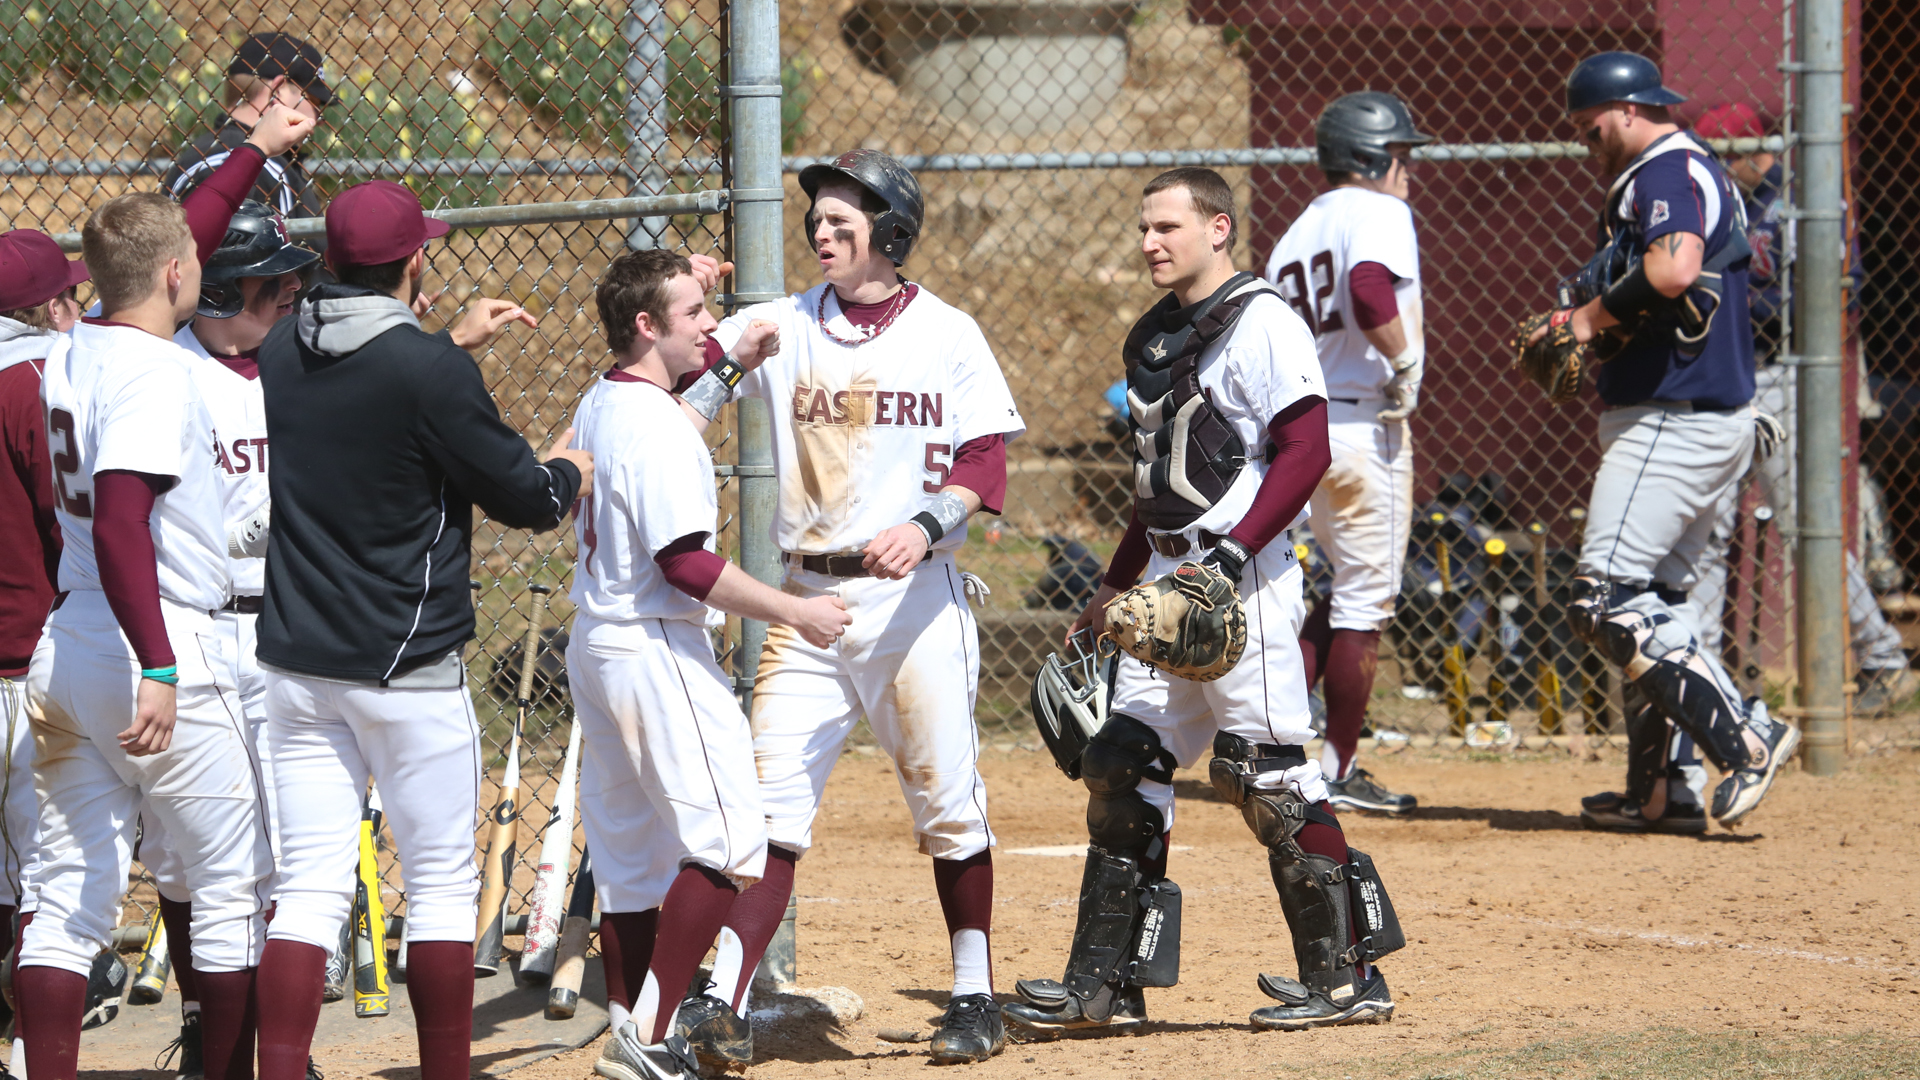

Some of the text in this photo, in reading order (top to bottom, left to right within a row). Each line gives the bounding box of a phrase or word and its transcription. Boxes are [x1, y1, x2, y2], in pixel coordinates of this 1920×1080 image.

[791, 383, 944, 429] EASTERN
[921, 442, 951, 495] 5
[1145, 908, 1159, 931] KNEE
[1137, 929, 1153, 958] SAVER
[1147, 924, 1162, 961] EASTON
